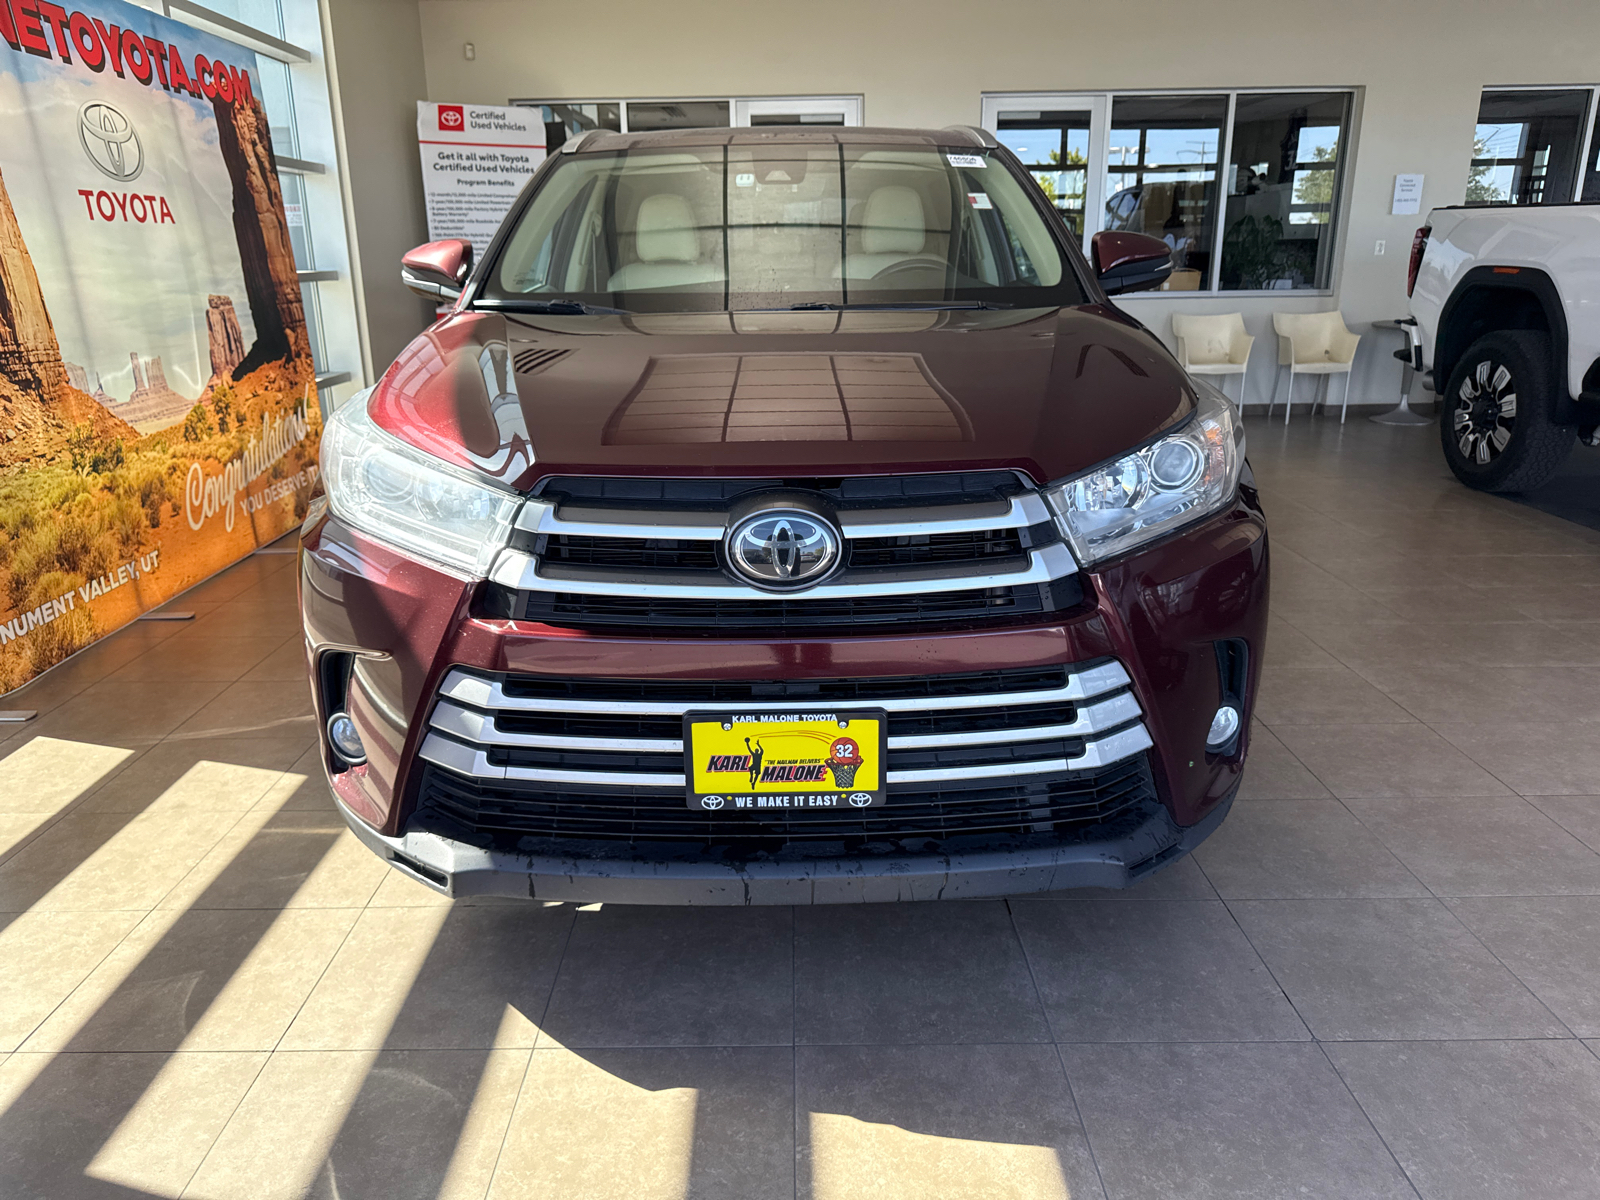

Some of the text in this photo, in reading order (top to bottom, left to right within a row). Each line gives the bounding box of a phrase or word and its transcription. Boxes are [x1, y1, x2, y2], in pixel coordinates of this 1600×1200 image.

[469, 110, 506, 120] Certified
[470, 121, 527, 132] Used Vehicles
[437, 151, 530, 165] Get it all with Toyota
[433, 162, 535, 174] Certified Used Vehicles
[456, 178, 515, 188] Program Benefits
[77, 189, 176, 225] TOYOTA
[240, 489, 264, 517] YOU
[263, 471, 308, 505] DESERVE
[78, 561, 141, 603] VALLEY,
[141, 550, 160, 573] UT
[731, 714, 838, 723] KARL MALONE TOYOTA
[835, 744, 853, 758] 32
[706, 755, 751, 773] KARL
[759, 764, 827, 783] MALONE
[735, 794, 839, 808] WE MAKE IT EASY
